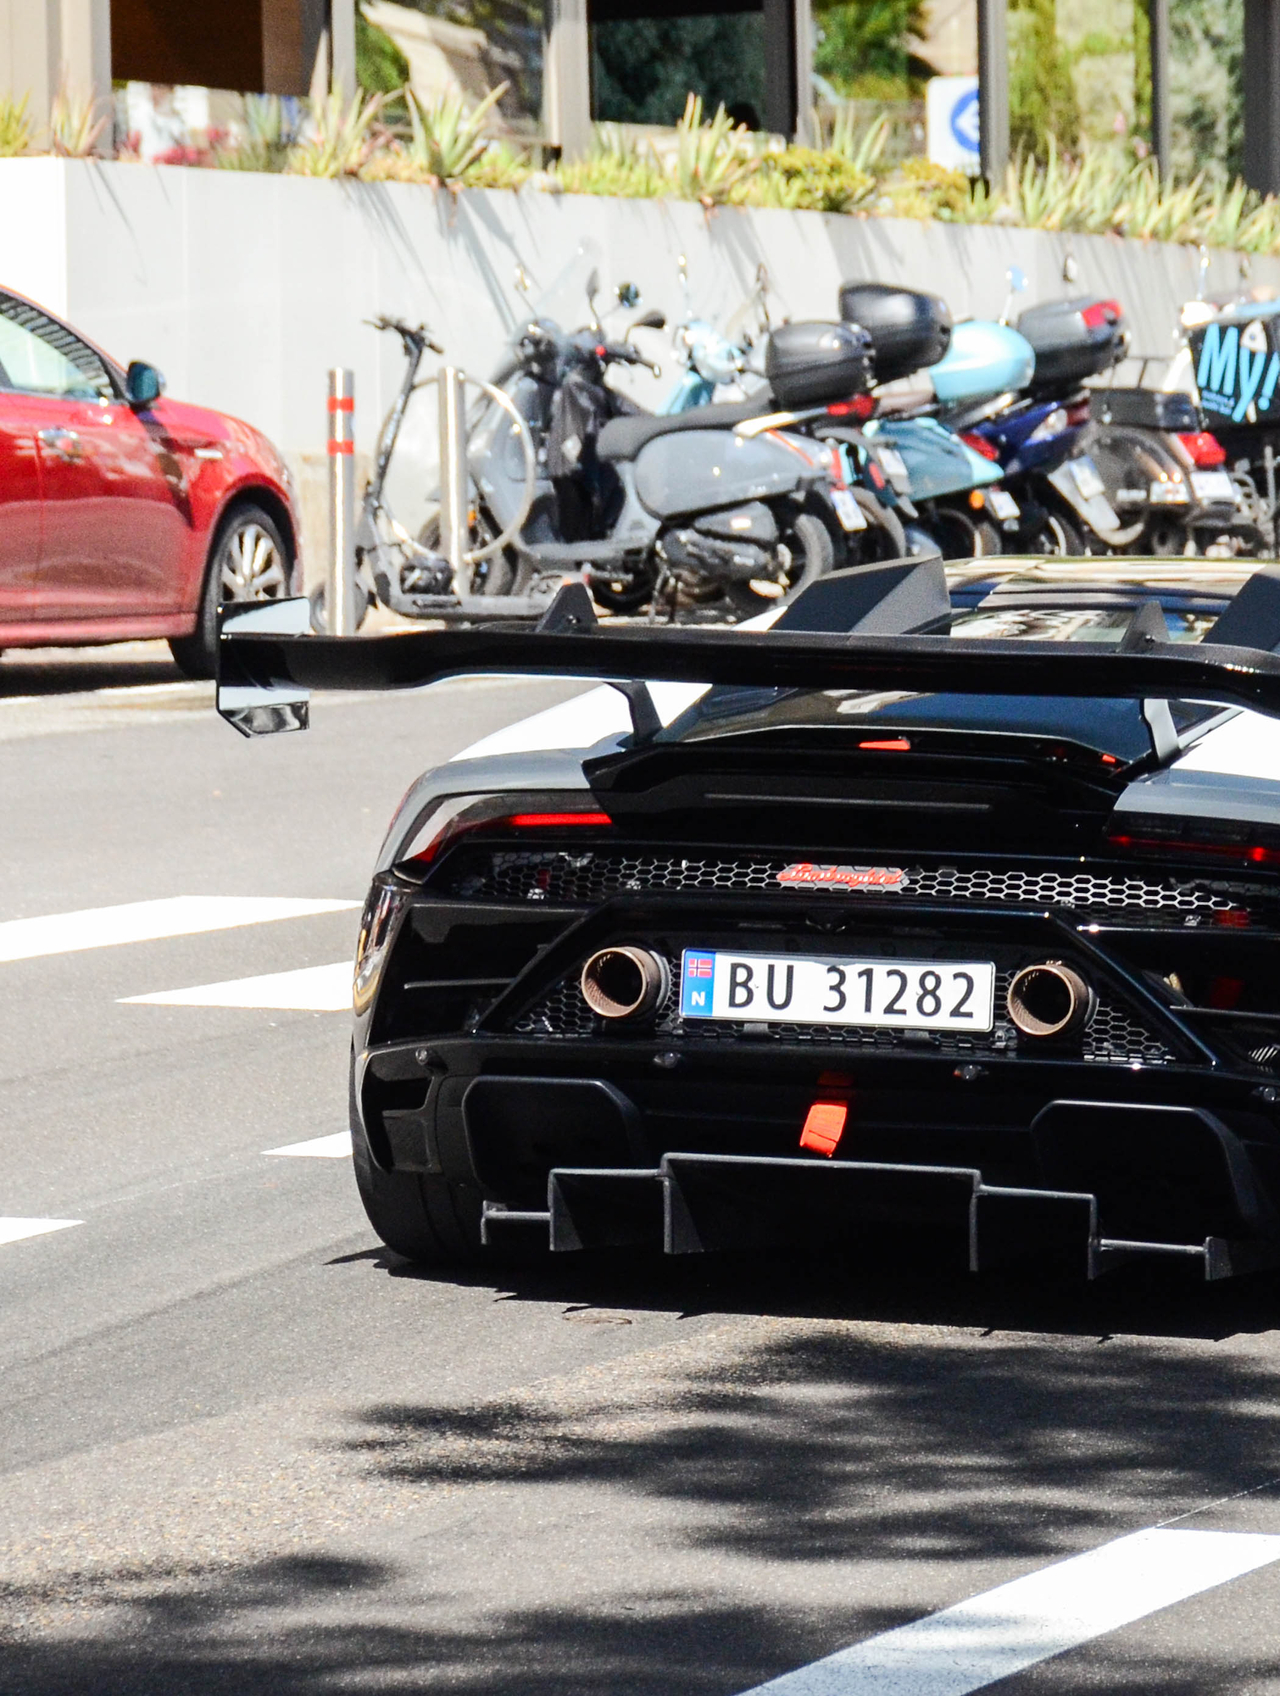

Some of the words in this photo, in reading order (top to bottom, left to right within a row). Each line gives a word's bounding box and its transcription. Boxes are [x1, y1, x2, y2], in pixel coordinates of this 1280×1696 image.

[691, 991, 706, 1007] N
[728, 962, 795, 1010] BU
[823, 965, 975, 1019] 31282
